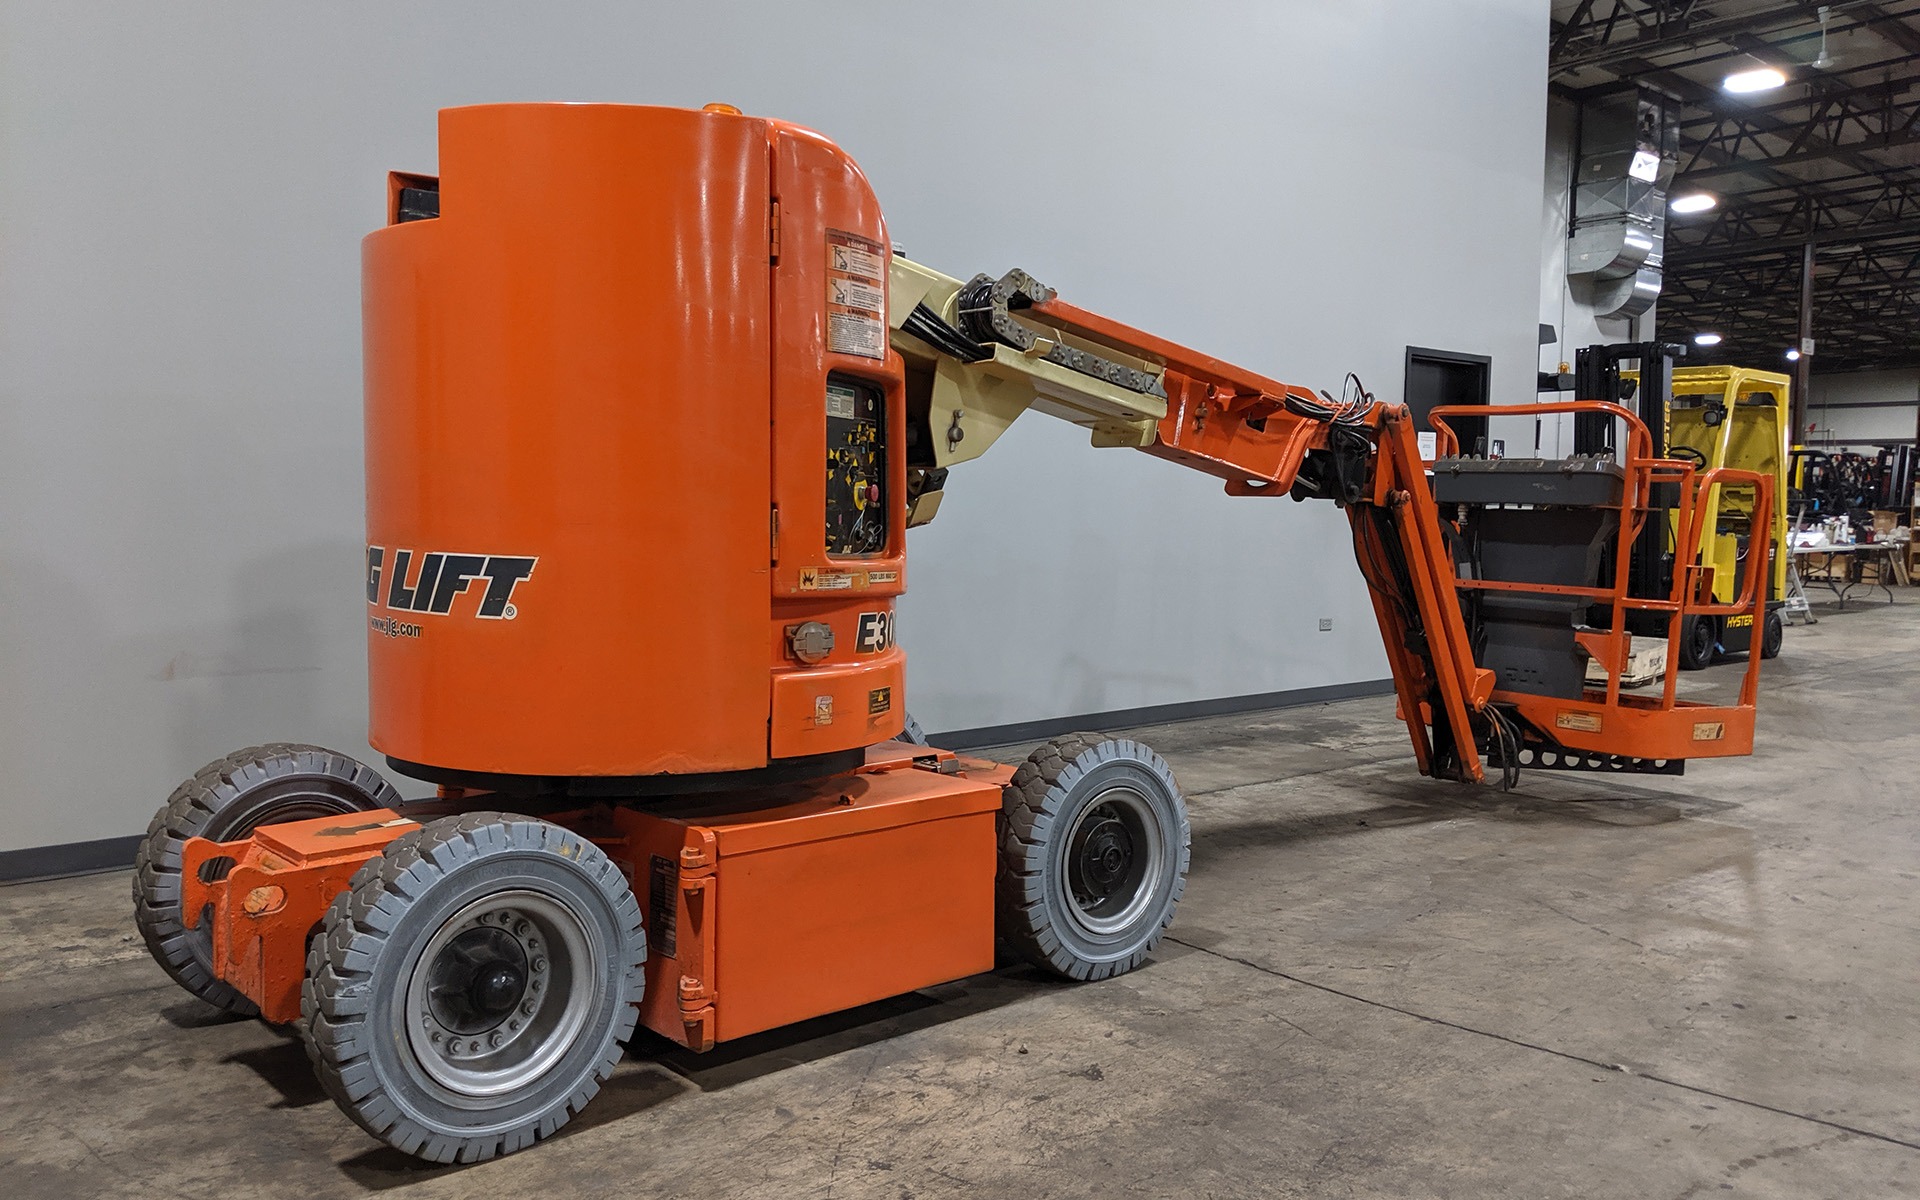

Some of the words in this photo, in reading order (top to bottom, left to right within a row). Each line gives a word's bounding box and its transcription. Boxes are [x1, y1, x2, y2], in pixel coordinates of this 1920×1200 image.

[366, 544, 386, 606] G
[855, 610, 894, 654] E30
[1726, 614, 1754, 629] HYSTER
